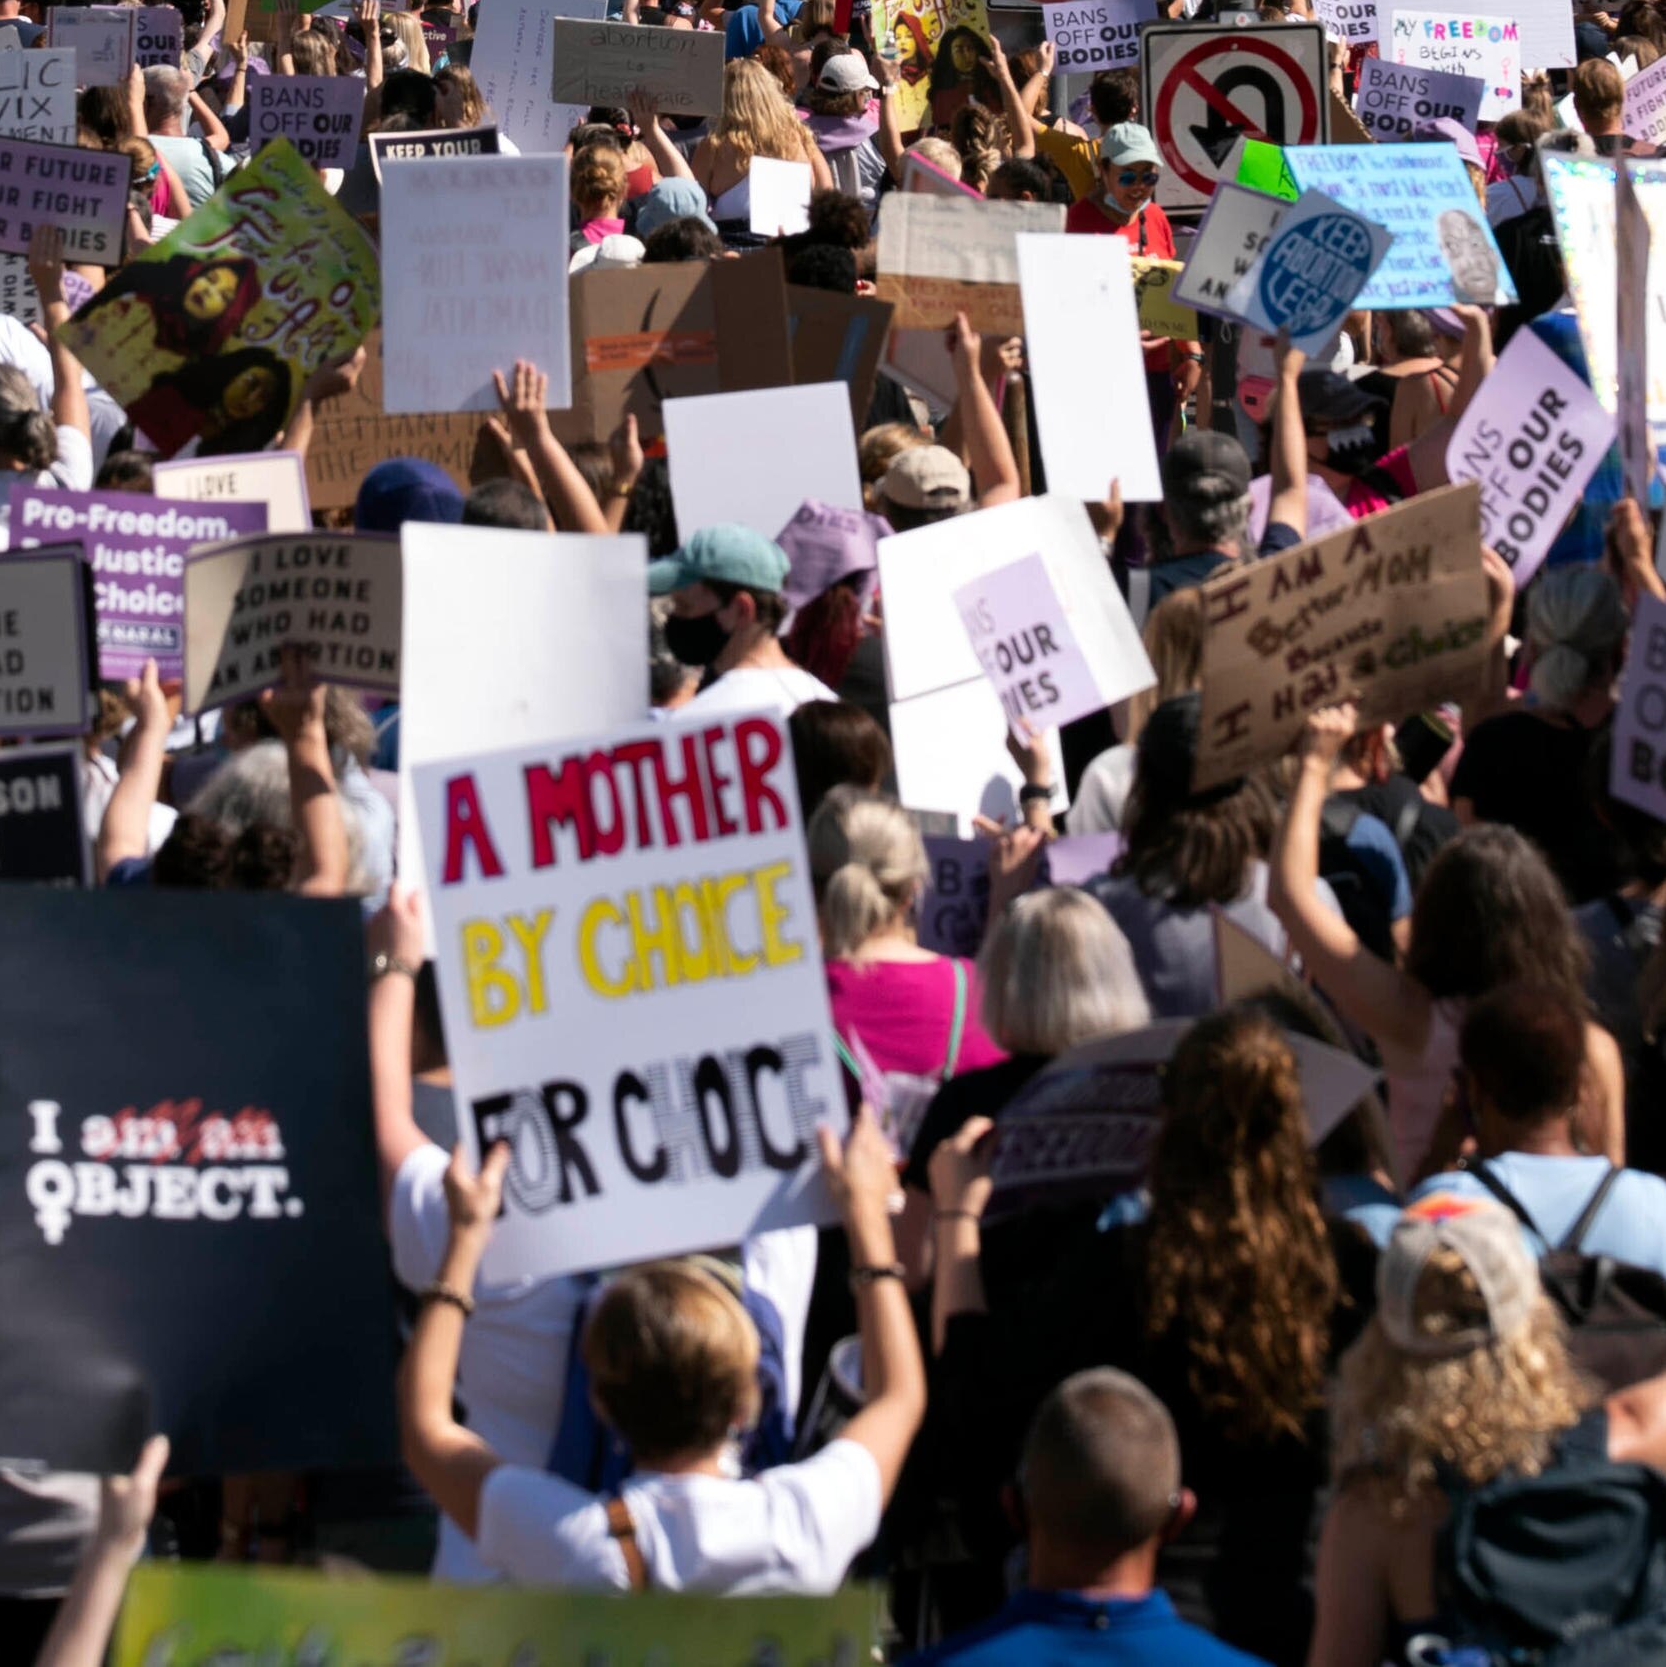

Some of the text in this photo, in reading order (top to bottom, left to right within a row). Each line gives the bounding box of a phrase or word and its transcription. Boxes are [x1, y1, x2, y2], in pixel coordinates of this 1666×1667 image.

[1051, 8, 1109, 32] BANS
[1054, 22, 1143, 48] OFF OUR
[1424, 18, 1519, 43] FREEDOM
[1057, 43, 1140, 65] BODIES
[25, 154, 118, 186] FUTURE
[35, 189, 103, 218] FIGHT
[1310, 215, 1370, 260] KEEP
[1271, 236, 1362, 301] ABORTION
[1507, 387, 1569, 473] OUR
[22, 498, 238, 540] Pro-Freedom.
[1493, 432, 1586, 567] BODIES
[253, 545, 352, 574] I LOVE
[233, 577, 372, 614] SOMEONE
[439, 714, 789, 888] A MOTHER
[459, 857, 805, 1033] BY CHOICE
[26, 1098, 63, 1156] I
[469, 1031, 829, 1220] FOR CHOICE
[23, 1159, 304, 1246] OBJECT.
